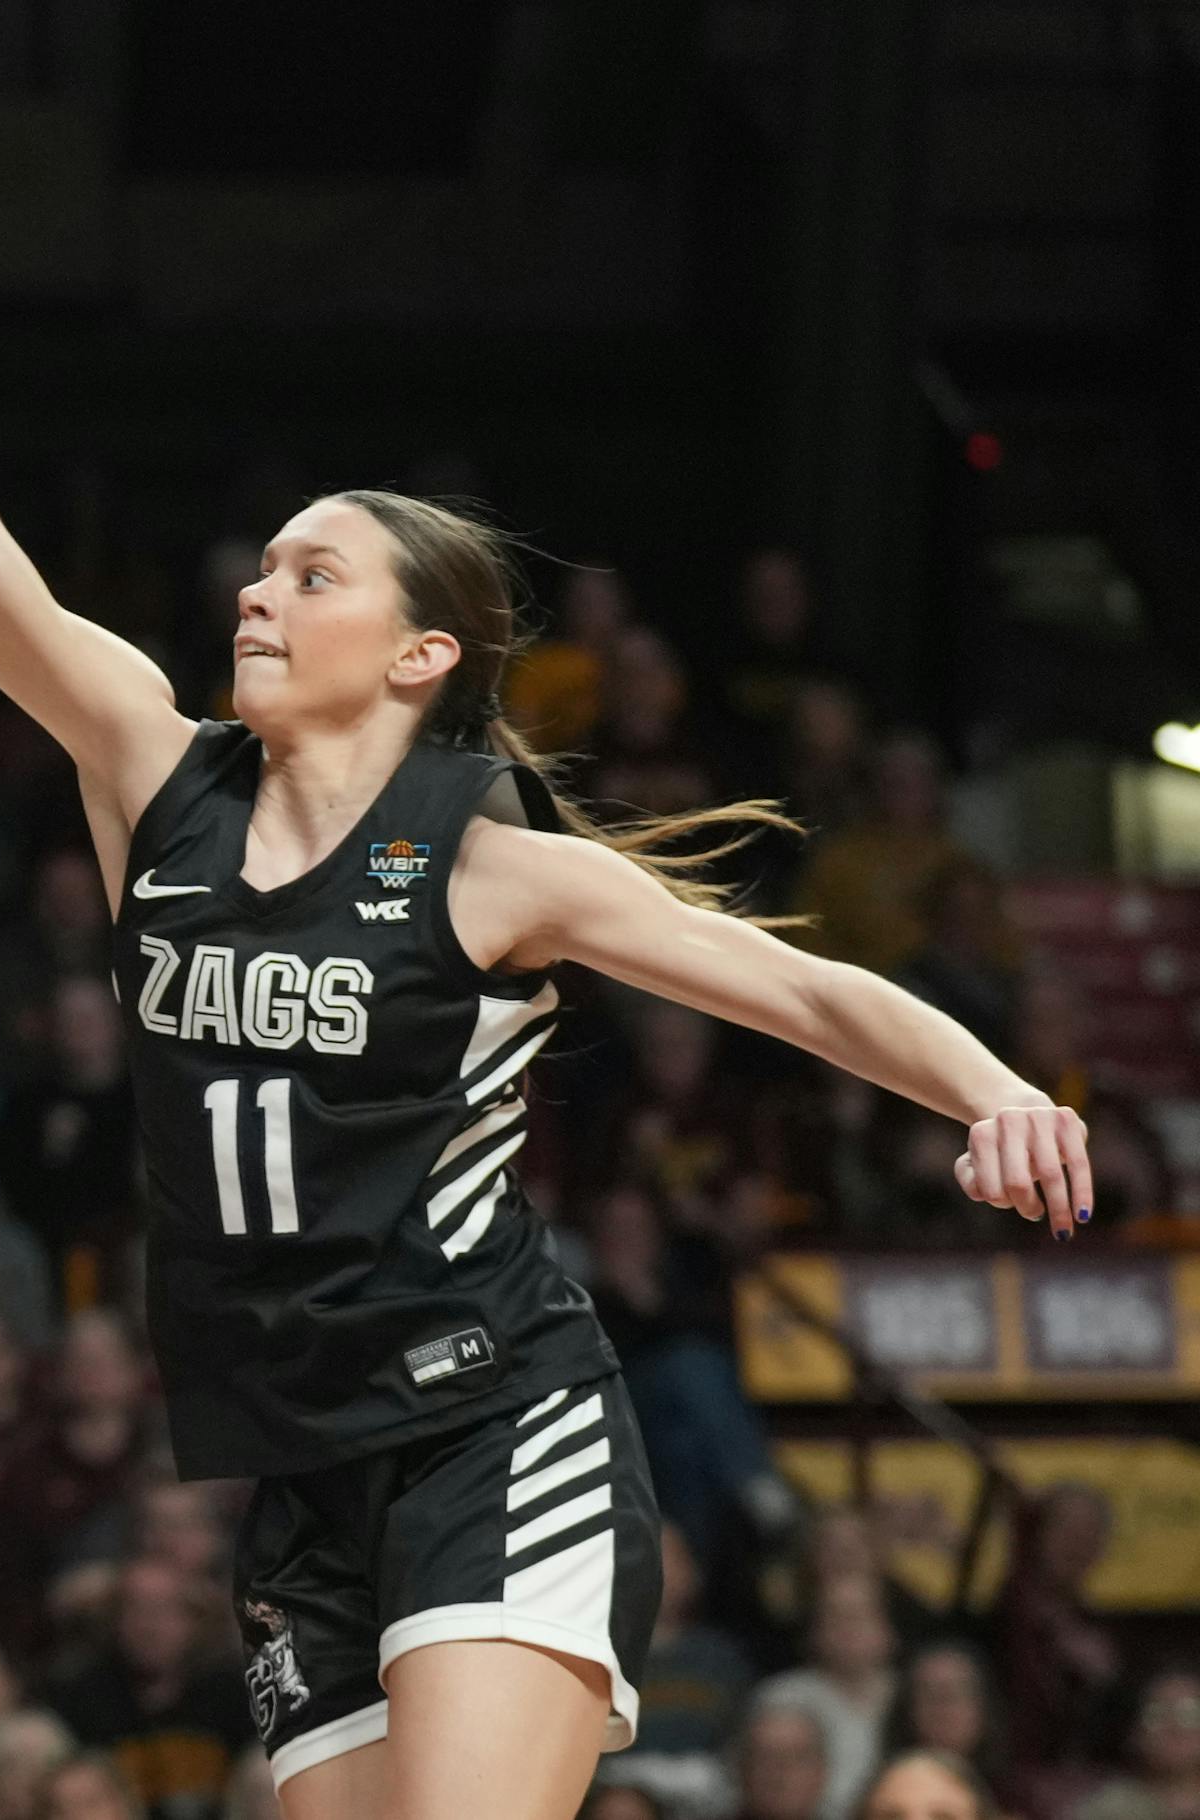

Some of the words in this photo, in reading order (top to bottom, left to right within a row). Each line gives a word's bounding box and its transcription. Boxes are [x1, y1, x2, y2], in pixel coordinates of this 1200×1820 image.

[369, 856, 429, 872] WBIT
[354, 897, 411, 921] WCC
[138, 934, 375, 1056] ZAGS
[204, 1077, 300, 1235] 11
[460, 1338, 480, 1360] M
